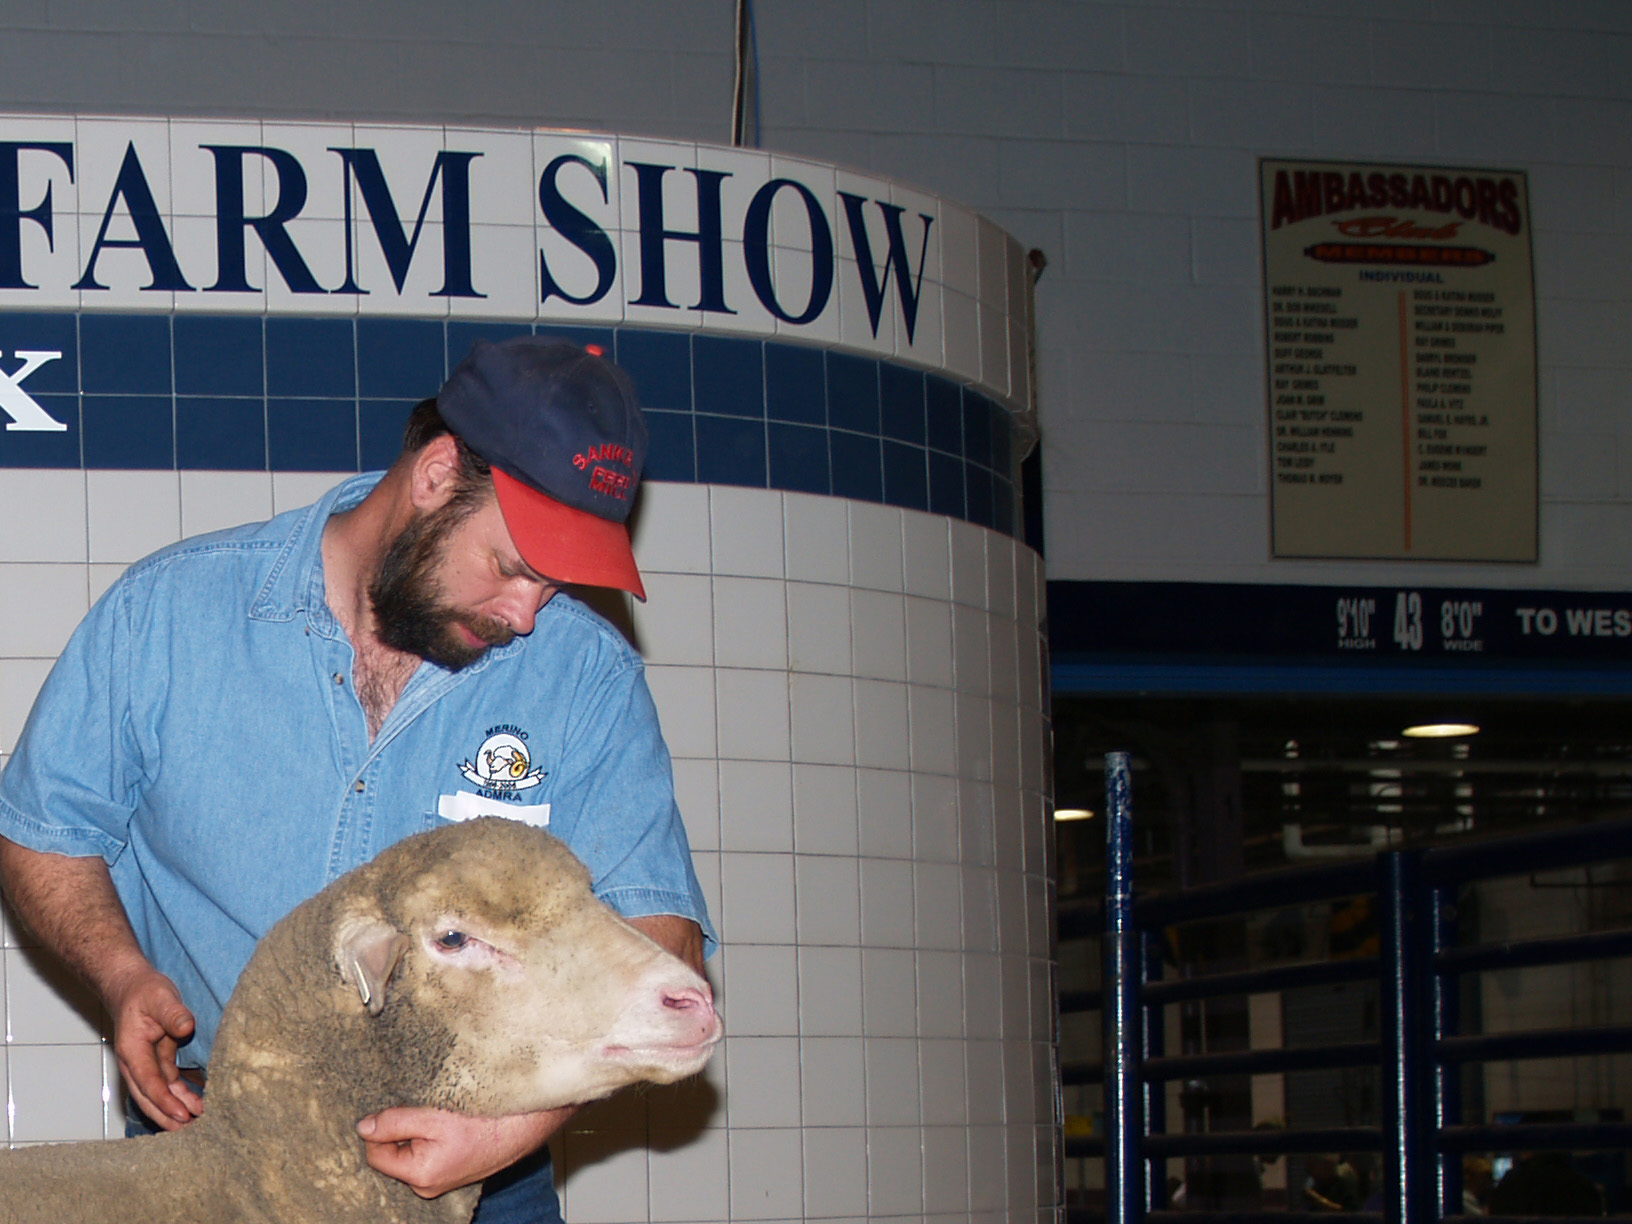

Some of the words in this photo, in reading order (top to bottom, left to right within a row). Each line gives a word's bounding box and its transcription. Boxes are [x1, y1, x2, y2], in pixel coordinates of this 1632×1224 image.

[1272, 170, 1522, 236] AMBASSADORS
[1333, 217, 1464, 240] Club
[538, 153, 934, 347] SHOW
[1359, 270, 1444, 284] INDIVIDUAL
[1337, 597, 1376, 638] 9'10"
[1393, 591, 1424, 650] 43
[1441, 600, 1483, 638] 8'0"
[1516, 608, 1558, 636] TO
[1338, 638, 1376, 649] HIGH
[1443, 639, 1484, 651] WIDE
[485, 723, 530, 741] MERINO
[476, 788, 522, 802] ADMRA
